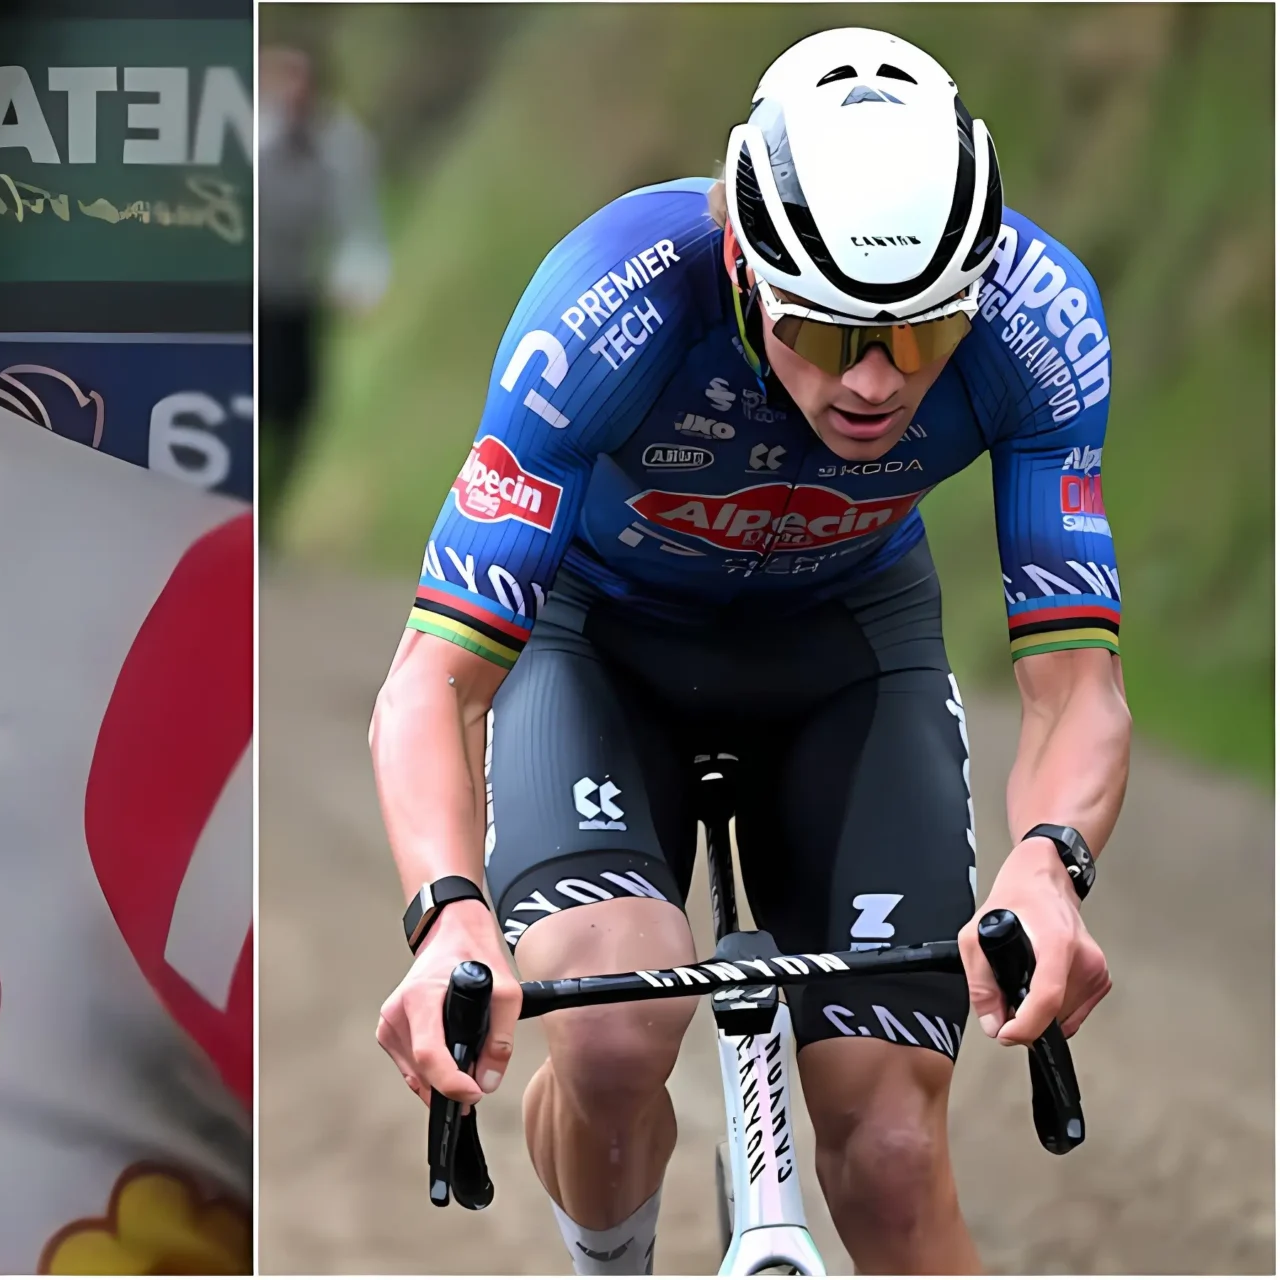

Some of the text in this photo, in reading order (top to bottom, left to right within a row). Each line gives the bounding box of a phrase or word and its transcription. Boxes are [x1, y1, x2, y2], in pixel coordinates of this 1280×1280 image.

[560, 239, 681, 341] PREMIER
[589, 296, 664, 370] TECH
[992, 223, 1111, 410] Alpecin
[1001, 312, 1081, 423] SHAMPOO
[656, 500, 894, 538] Alpecin
[636, 953, 851, 988] CANYON
